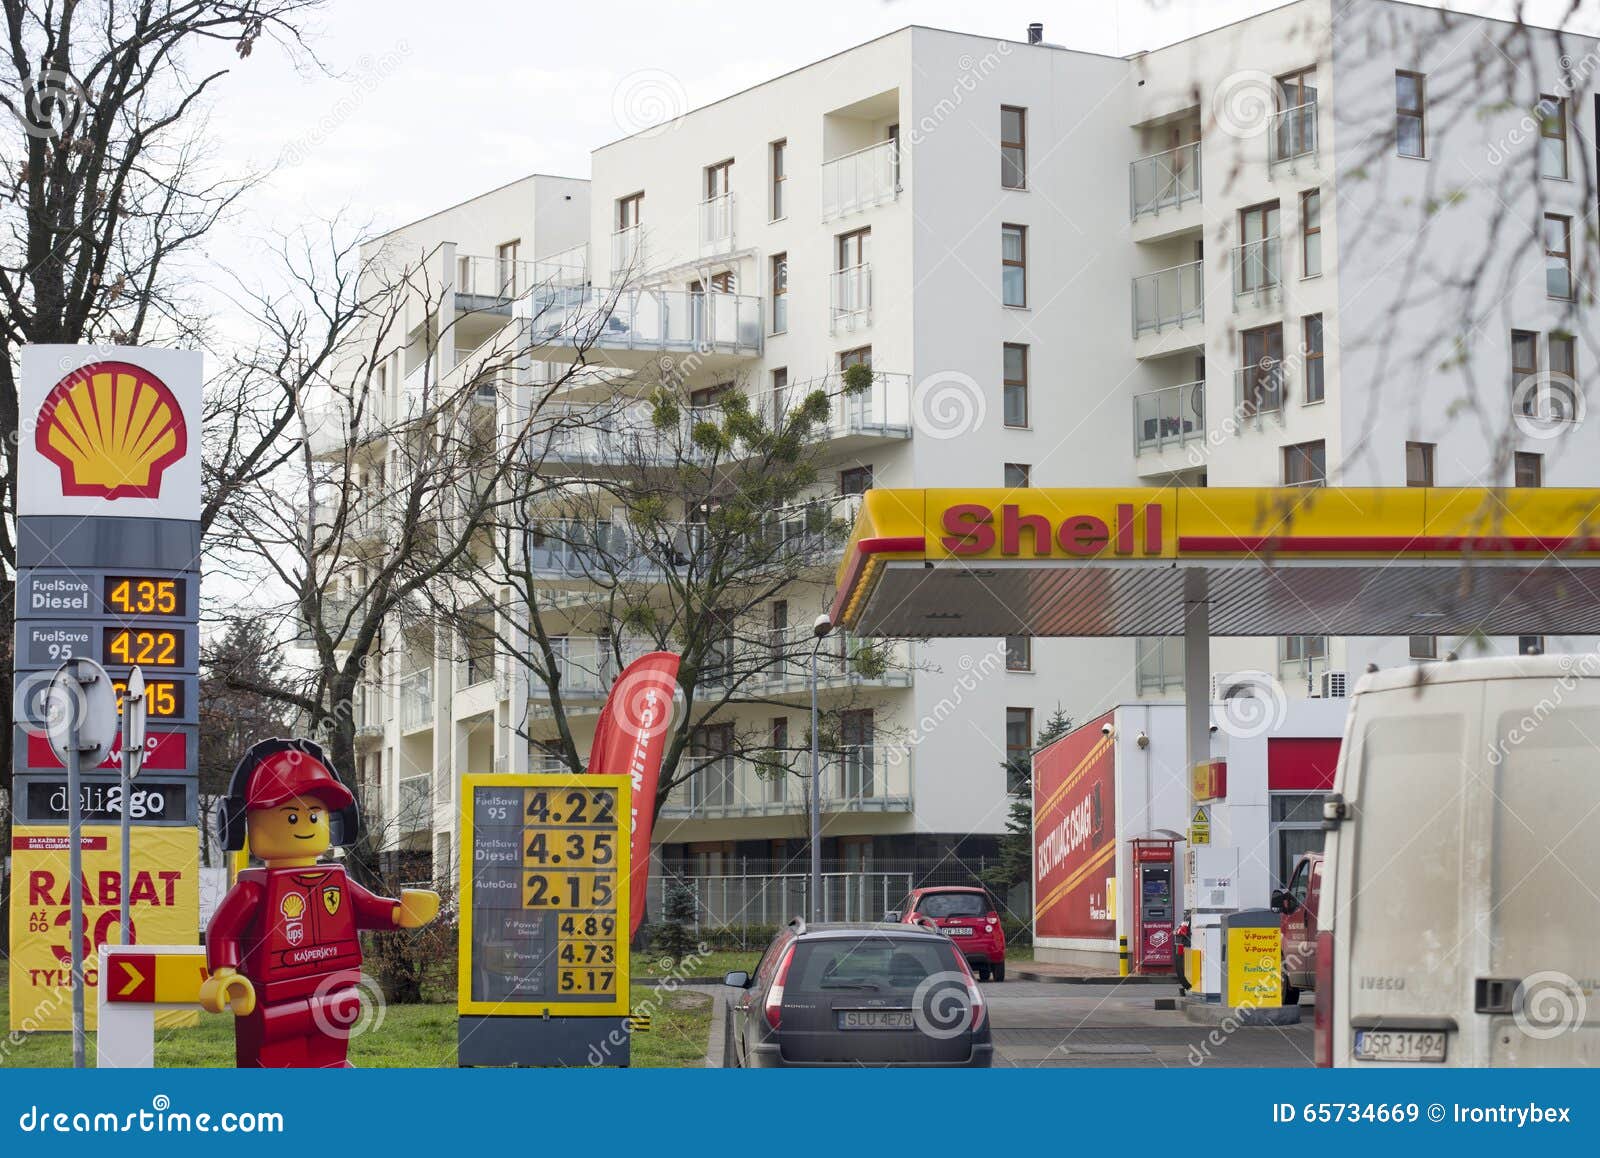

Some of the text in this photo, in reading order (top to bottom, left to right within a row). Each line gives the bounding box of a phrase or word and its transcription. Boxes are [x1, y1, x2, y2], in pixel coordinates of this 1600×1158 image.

[941, 503, 1163, 556] Shell
[32, 580, 89, 592] FuelSave
[32, 593, 88, 609] Diesel
[111, 581, 176, 613] 4.35
[32, 631, 89, 643] FuelSave
[48, 645, 72, 660] 95
[111, 632, 176, 664] 4.22
[476, 797, 518, 806] FuelSave
[526, 792, 614, 823] 4.22
[488, 808, 506, 819] 95
[476, 839, 518, 848] FuelSave
[526, 833, 613, 864] 4.35
[476, 850, 518, 861] Diesel
[29, 871, 181, 905] RABAT
[476, 880, 518, 889] AutoGas
[526, 875, 613, 907] 2.15
[29, 909, 47, 922] AŻ
[29, 923, 48, 933] DO
[561, 917, 615, 936] 4.89
[288, 930, 303, 942] ups
[561, 944, 615, 963] 4.73
[561, 972, 615, 991] 5.17
[1360, 977, 1405, 991] IVECO
[847, 1013, 876, 1026] SLU
[1363, 1034, 1443, 1057] DSR 31494
